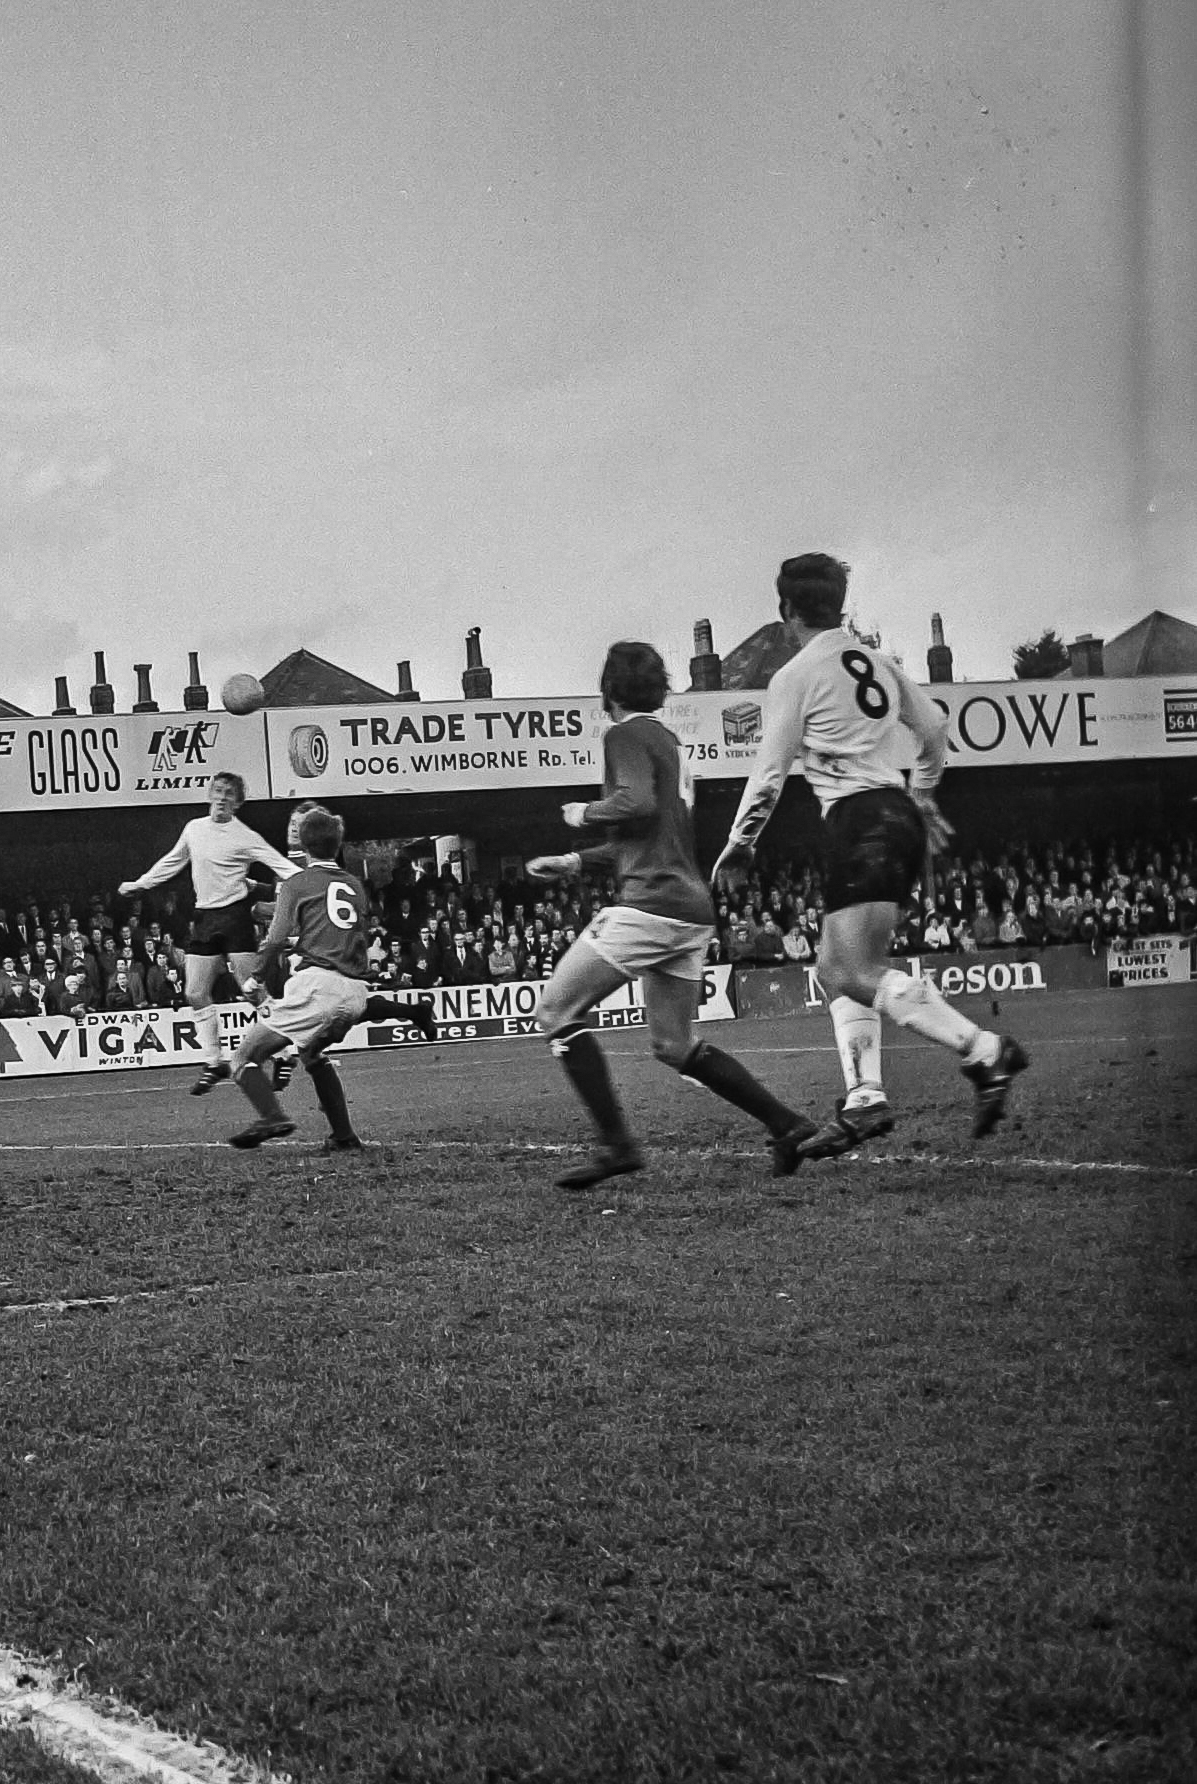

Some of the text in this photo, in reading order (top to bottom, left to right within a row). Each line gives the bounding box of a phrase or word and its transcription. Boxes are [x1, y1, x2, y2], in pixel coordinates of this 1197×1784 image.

[842, 650, 889, 719] 8
[340, 713, 466, 746] TRADE
[475, 709, 583, 740] TYRES
[28, 728, 120, 795] GLASS
[410, 750, 528, 773] WIMBORNE
[570, 749, 597, 766] Tel.
[327, 881, 358, 929] 6
[1118, 953, 1167, 967] LOWEST
[75, 1012, 160, 1027] EDWARD
[599, 1008, 644, 1027] Frid
[37, 1021, 203, 1060] VIGAR
[99, 1056, 144, 1066] WINTON
